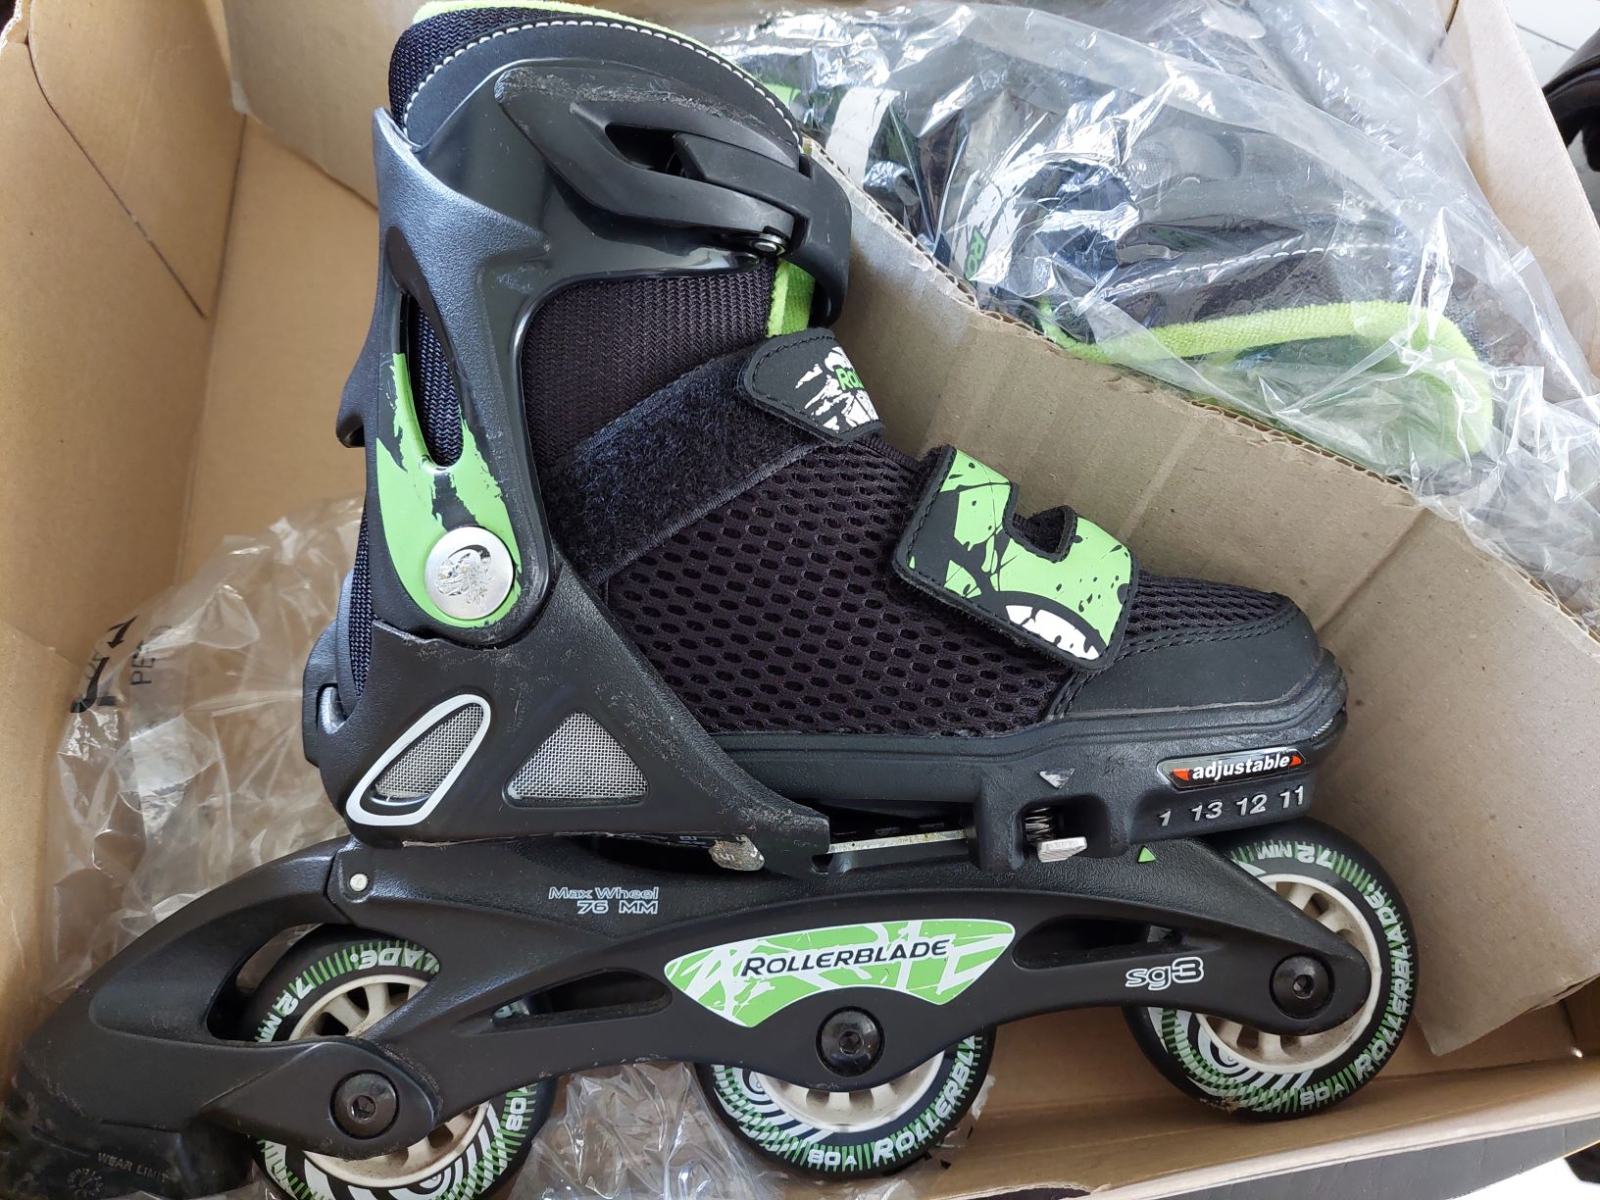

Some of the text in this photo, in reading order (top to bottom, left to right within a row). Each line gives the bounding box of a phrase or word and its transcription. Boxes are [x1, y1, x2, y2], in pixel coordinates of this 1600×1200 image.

[1192, 753, 1290, 781] adjustable
[1159, 785, 1304, 827] 1 13 12 11
[548, 886, 659, 900] Max Wheel
[576, 900, 659, 914] 76 MM
[741, 939, 950, 976] ROLLERBLADE
[1125, 956, 1204, 991] sg3
[98, 1152, 134, 1172] WEAR
